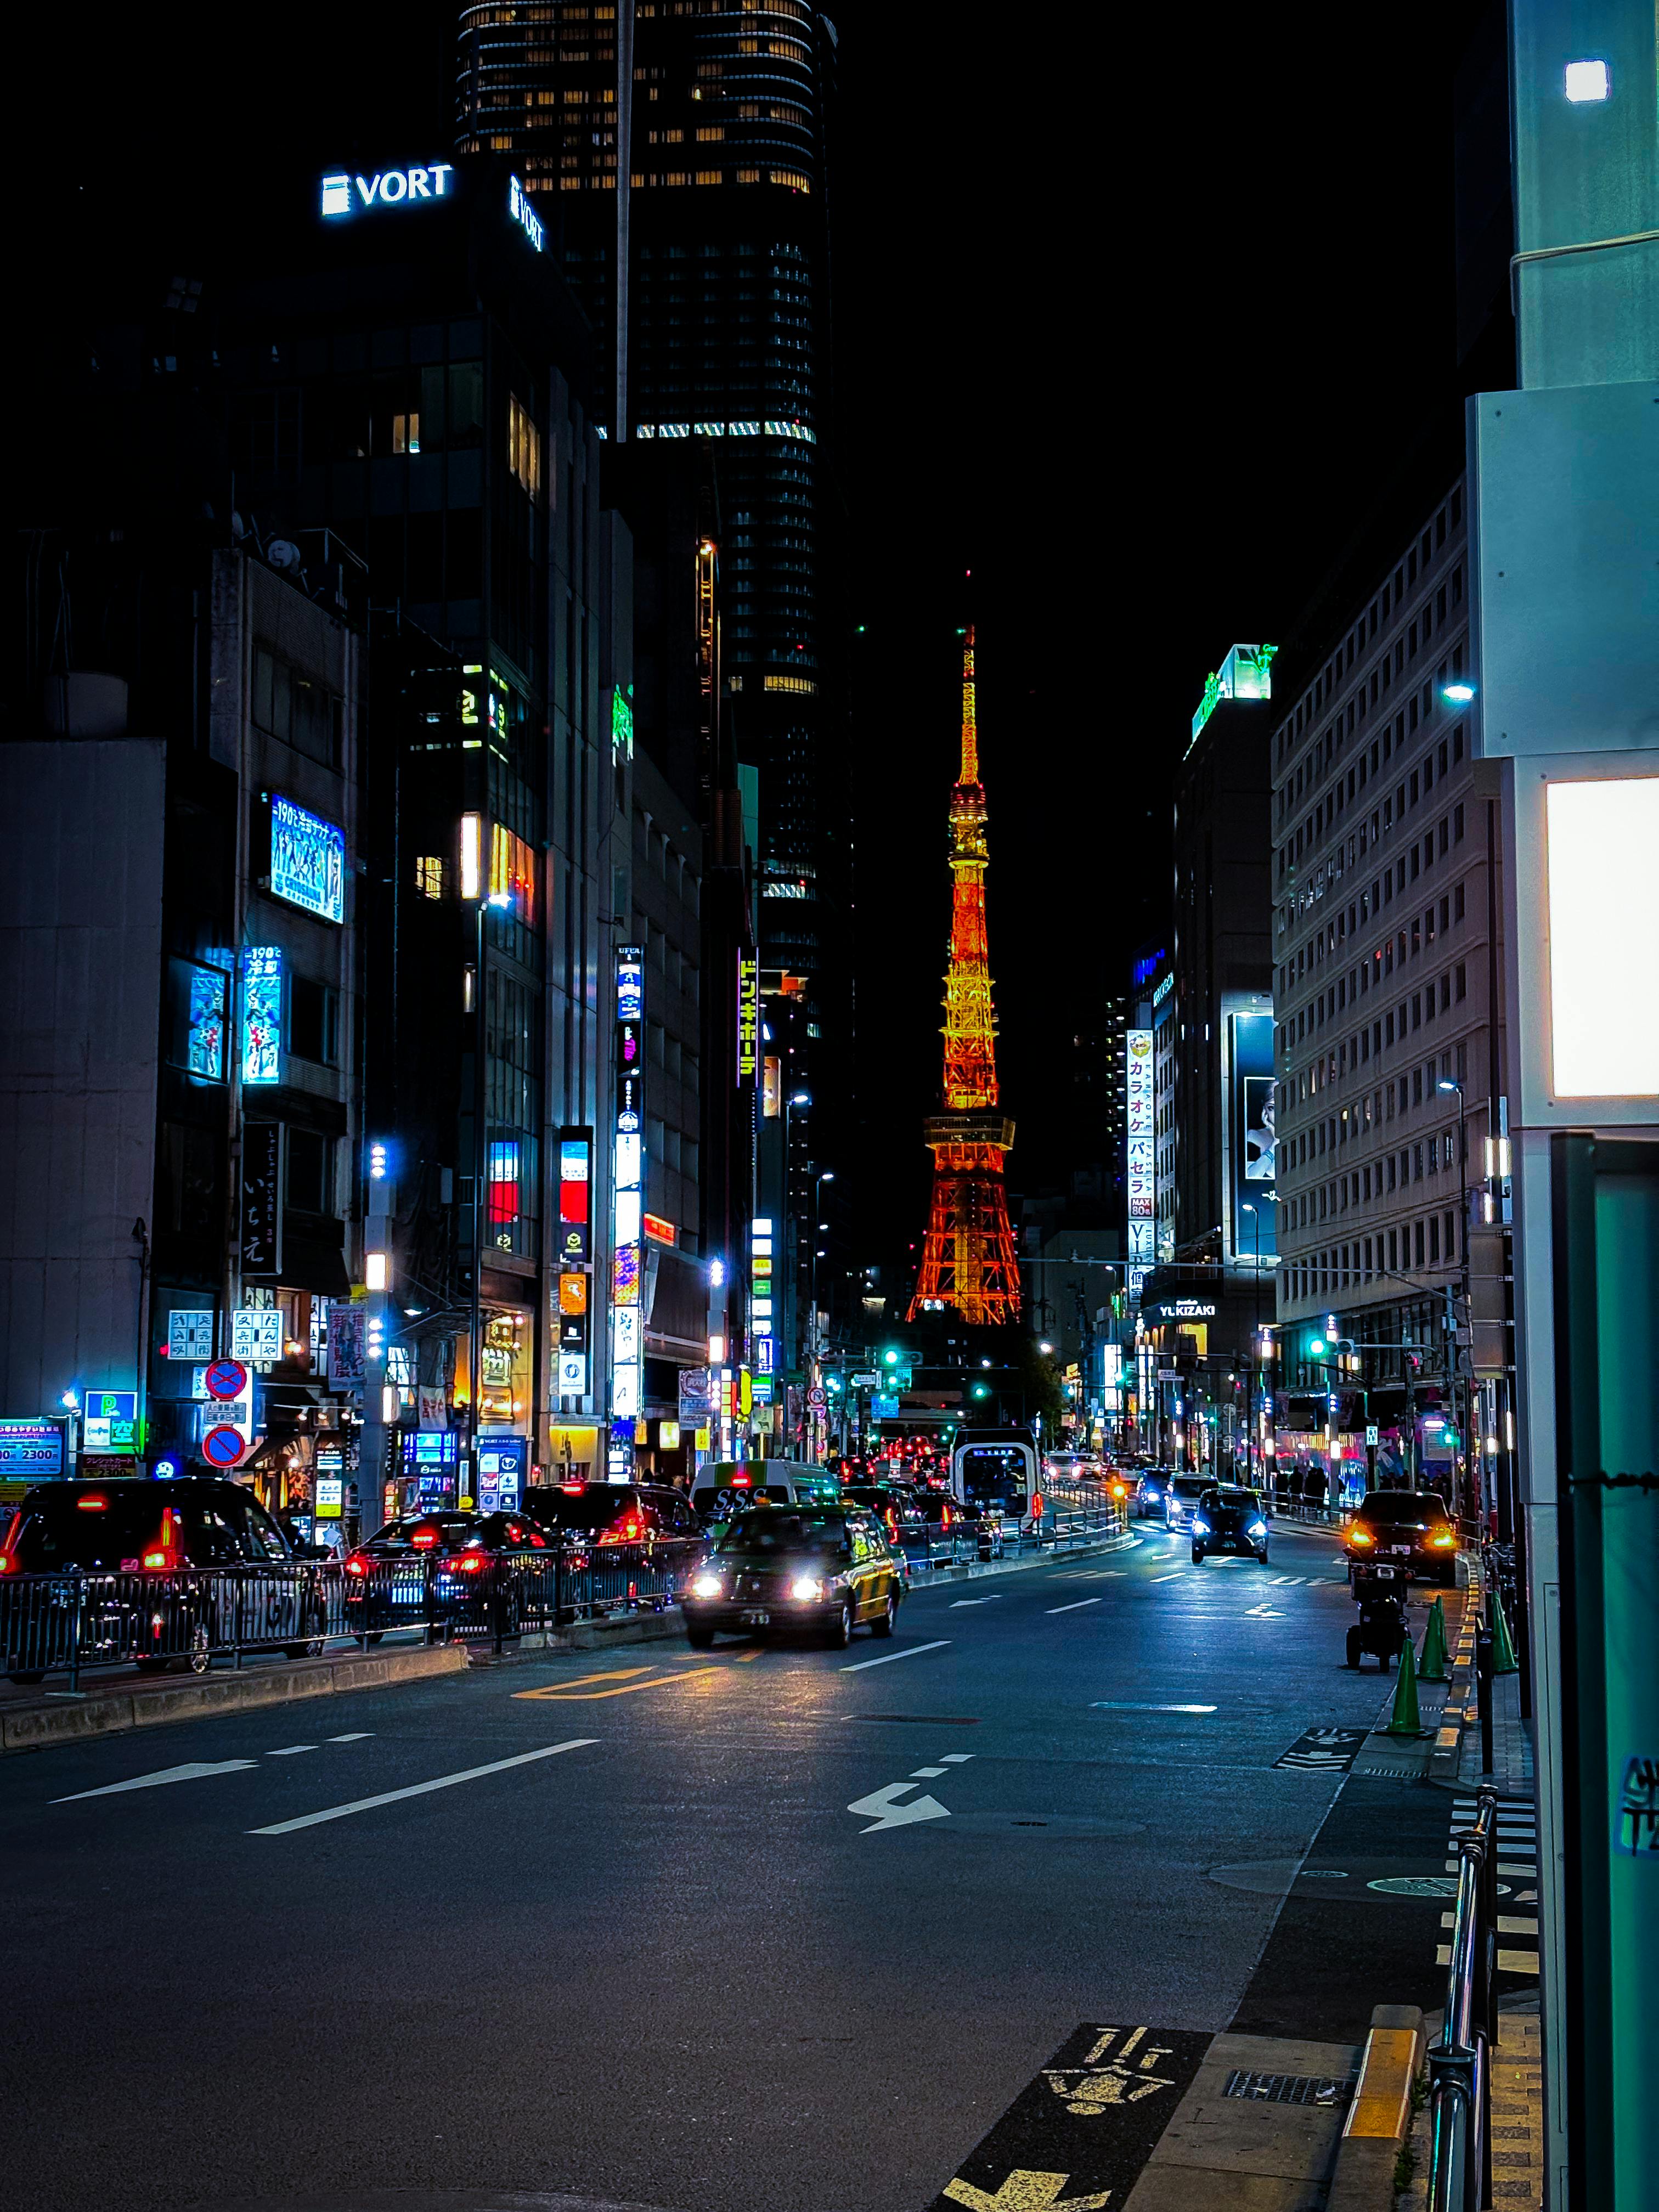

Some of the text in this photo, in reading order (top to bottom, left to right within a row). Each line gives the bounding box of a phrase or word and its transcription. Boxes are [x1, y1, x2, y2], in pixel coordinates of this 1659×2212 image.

[356, 165, 453, 206] VORT
[519, 193, 543, 252] VORT
[740, 961, 756, 1075] ドン・キホーテ
[1130, 1062, 1144, 1132] カラオケ
[1130, 1141, 1144, 1194] パセラ
[1130, 1224, 1145, 1269] VIP
[1160, 1305, 1215, 1317] YUKIZAKI
[111, 1420, 134, 1443] 空
